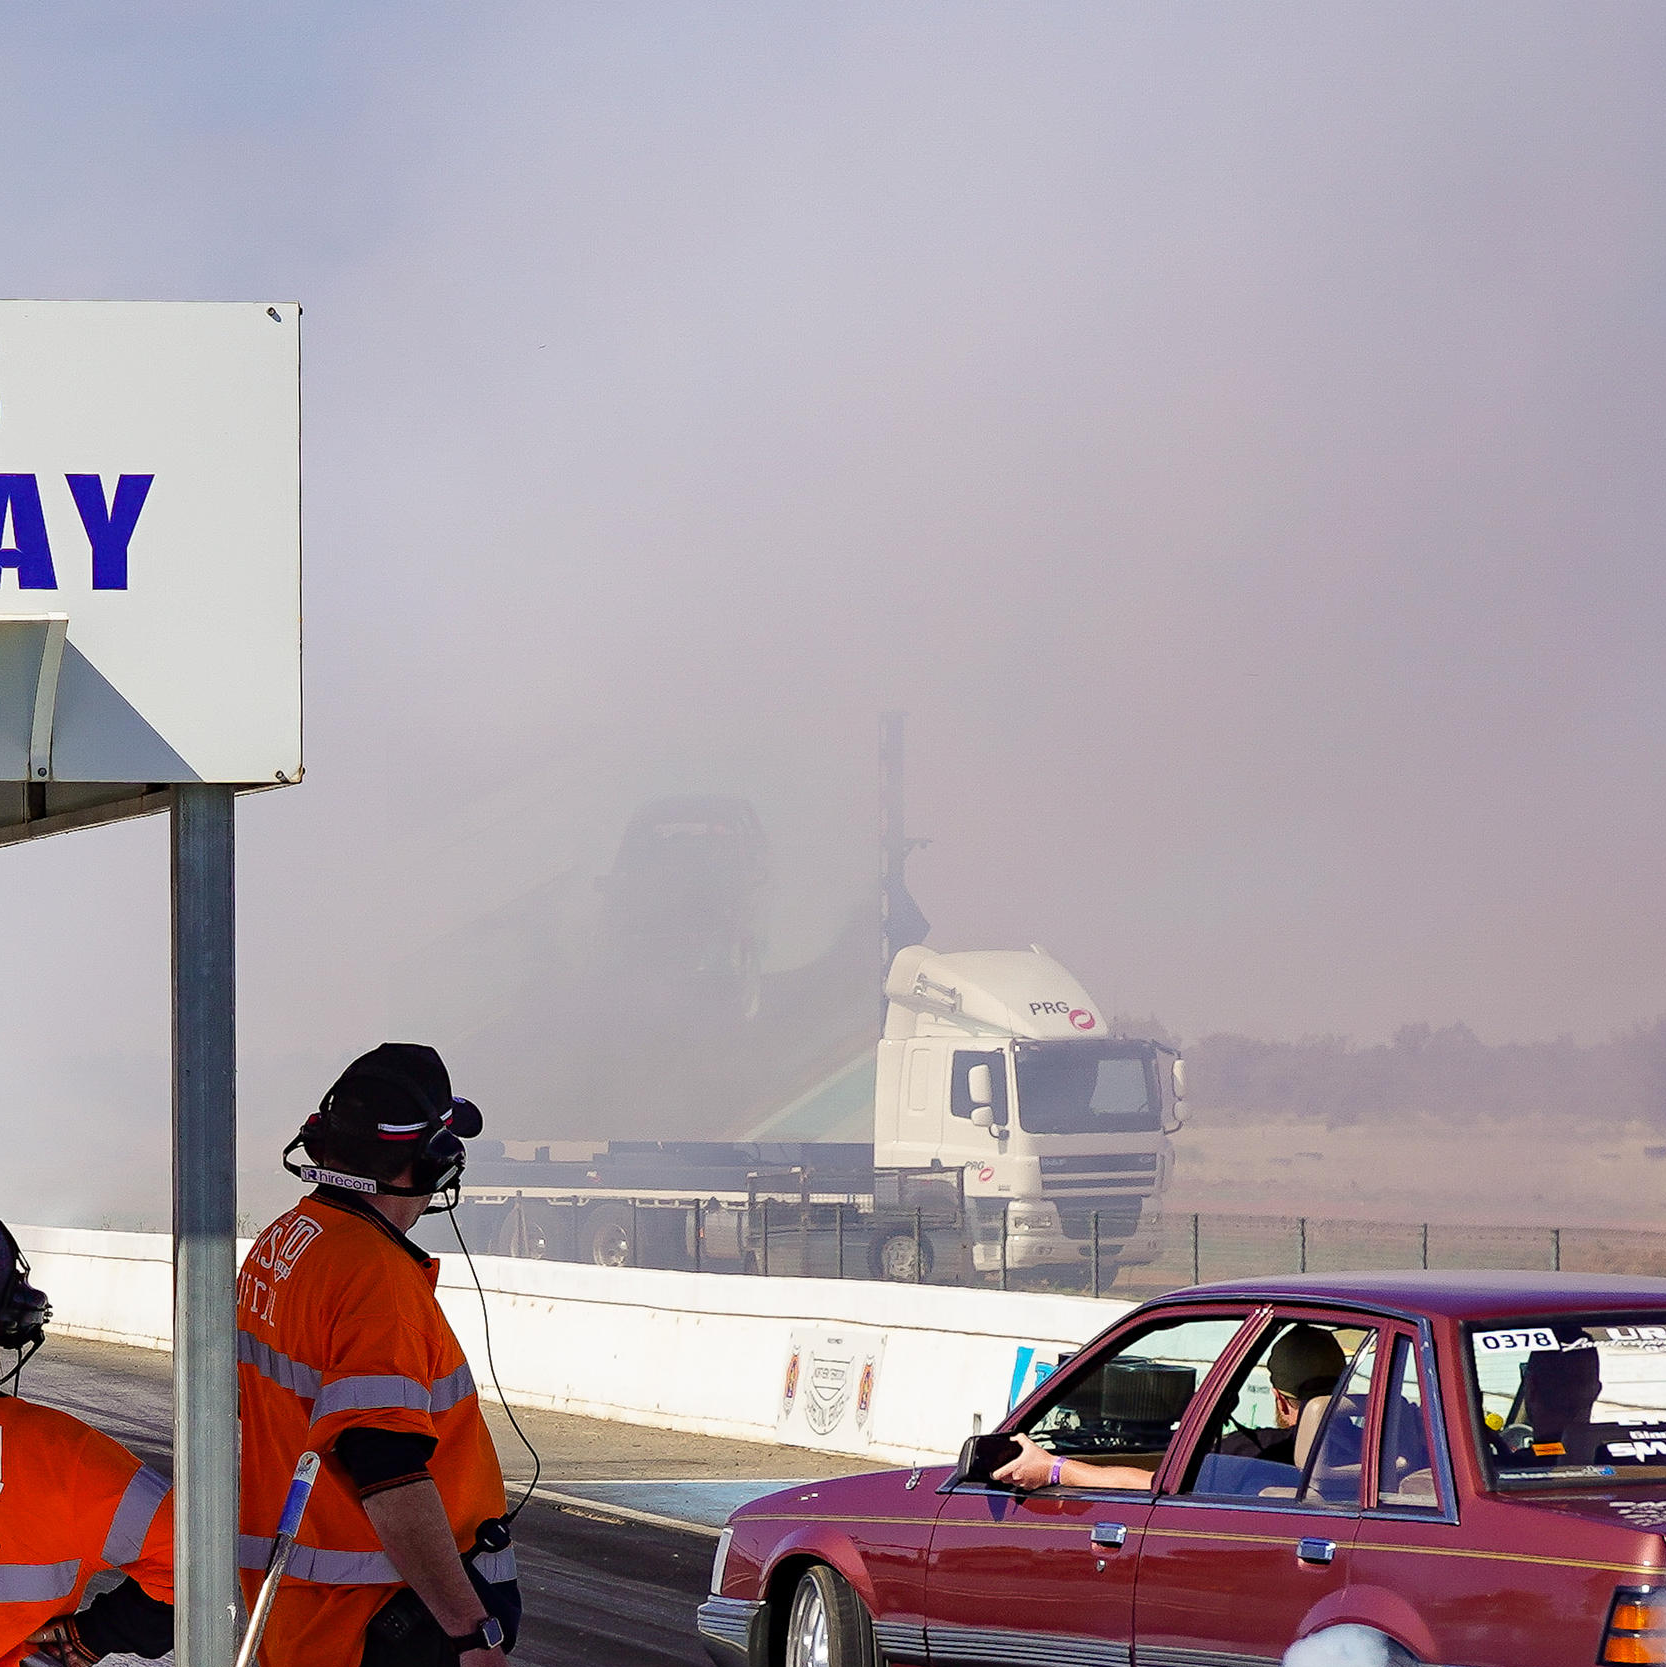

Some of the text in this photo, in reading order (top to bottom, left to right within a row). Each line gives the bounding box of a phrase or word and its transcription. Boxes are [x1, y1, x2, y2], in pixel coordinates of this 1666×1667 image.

[1029, 1001, 1070, 1016] PRG
[319, 1171, 376, 1193] hirecom
[1482, 1332, 1552, 1350] 0378
